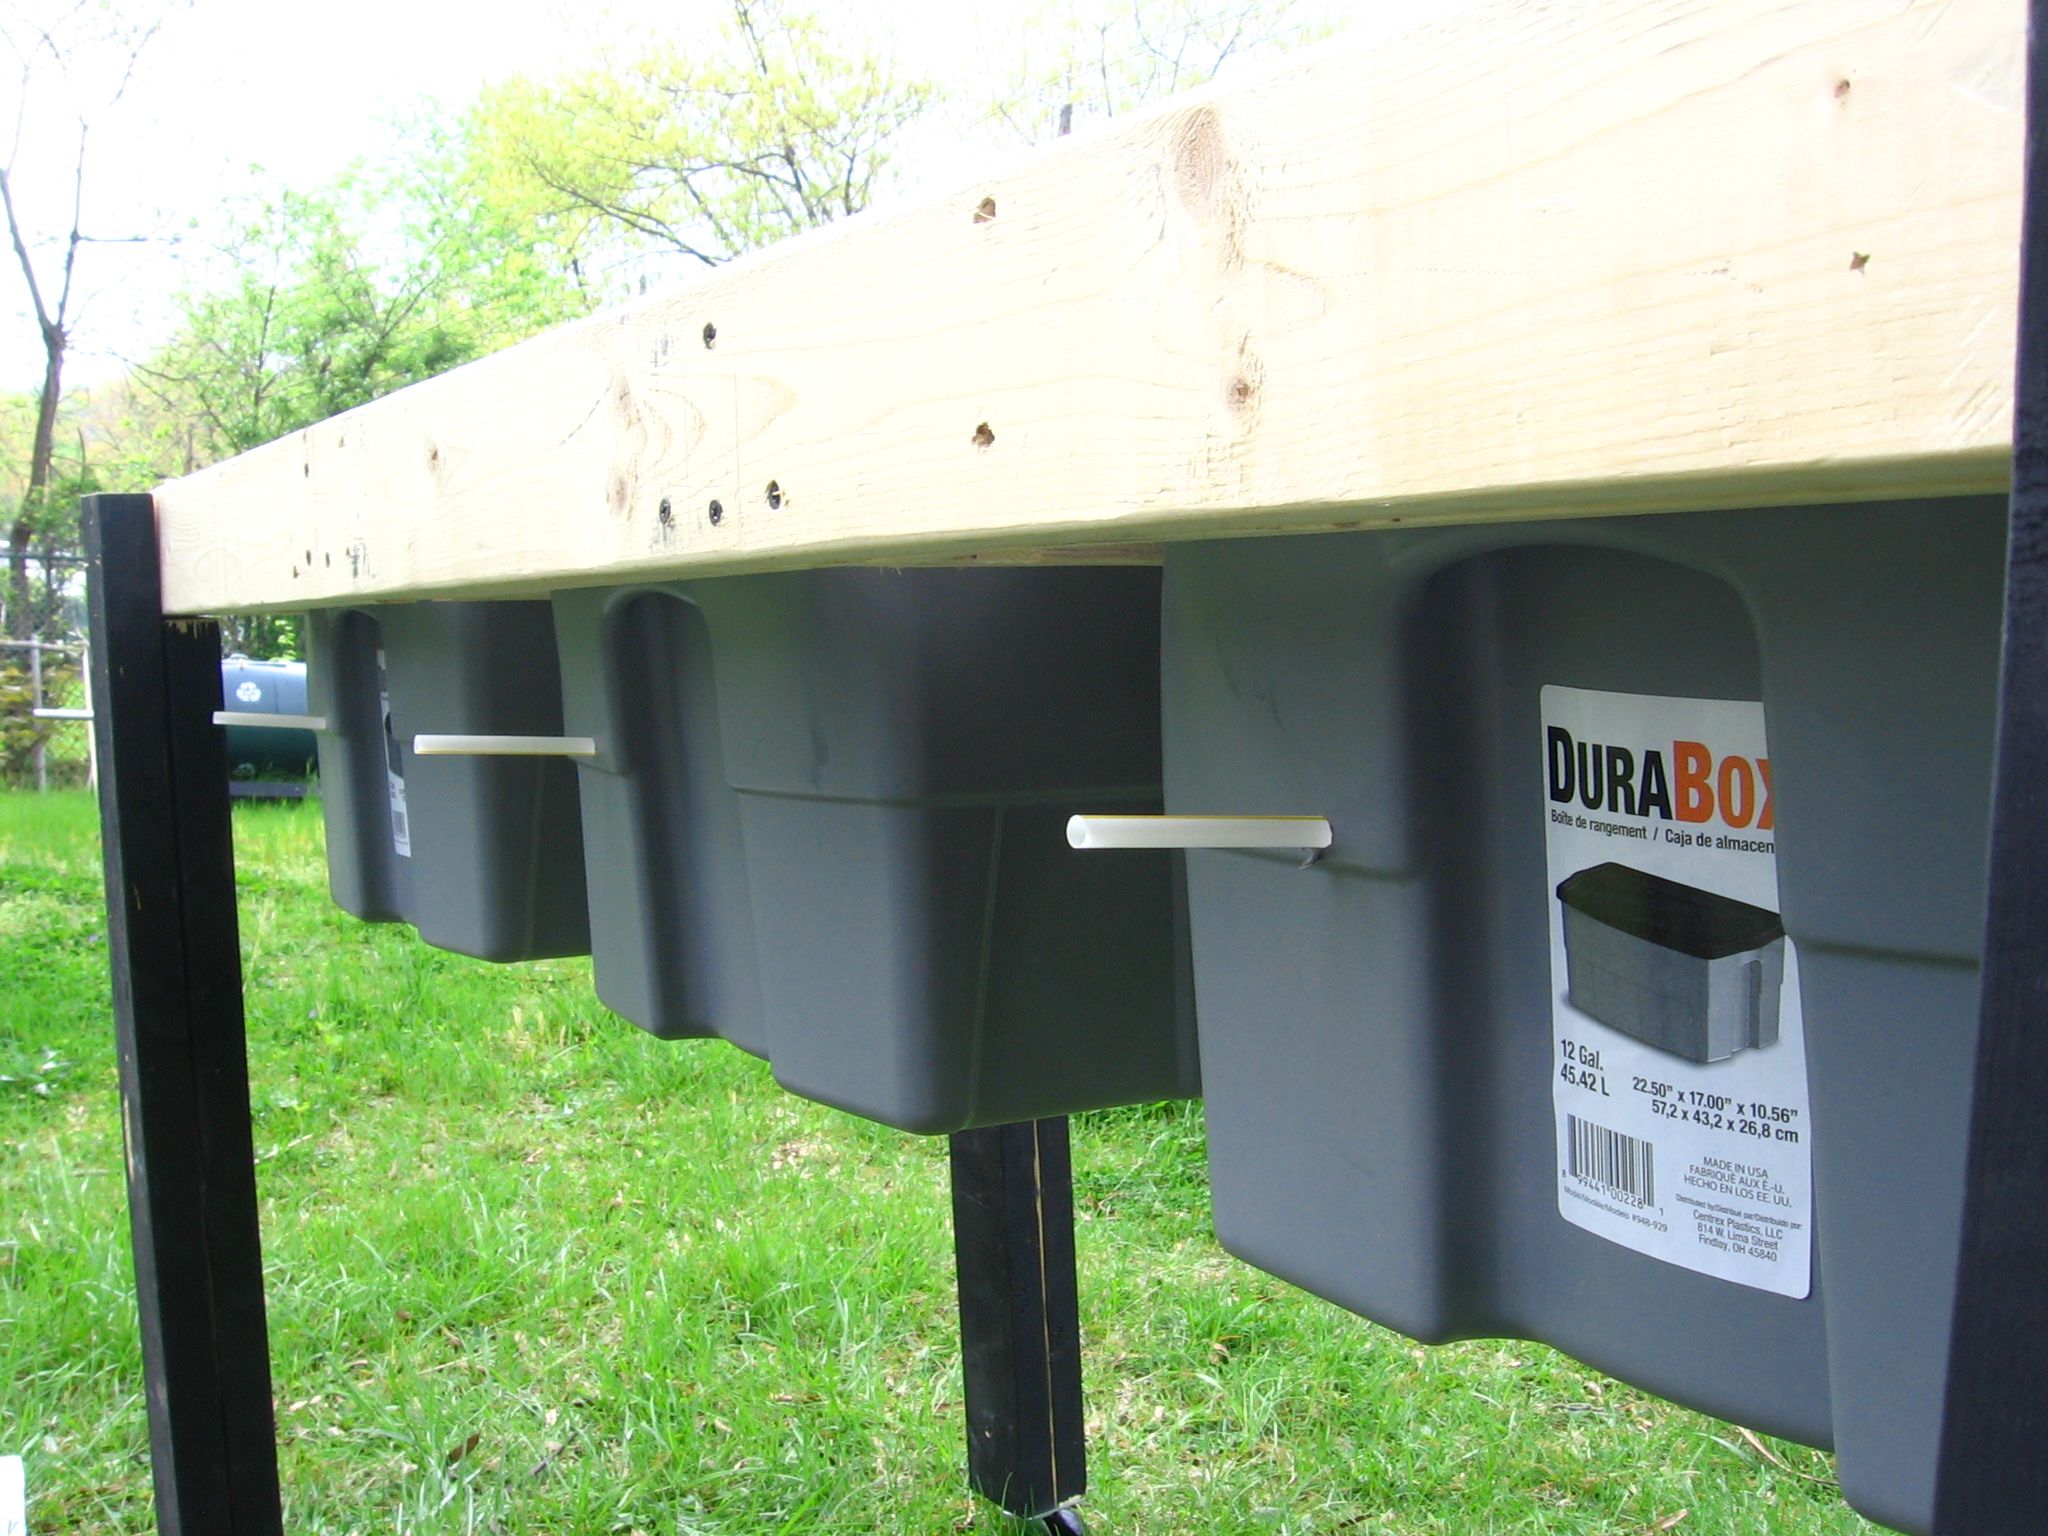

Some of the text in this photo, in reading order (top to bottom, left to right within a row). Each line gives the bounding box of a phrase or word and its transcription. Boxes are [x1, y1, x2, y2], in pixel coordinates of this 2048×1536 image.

[1575, 813, 1587, 828] de
[1589, 821, 1647, 839] rangement
[1653, 827, 1659, 841] /
[1665, 828, 1692, 847] Caja
[1696, 832, 1712, 848] de
[1561, 1039, 1604, 1071] 12 Gal.
[1560, 1063, 1610, 1097] 45.42 L
[1677, 1090, 1685, 1103] x
[1737, 1103, 1745, 1116] x
[1652, 1099, 1798, 1144] 57,2 x 43,2 x 26,8 cm
[1703, 1156, 1768, 1178] MADE IN USA
[1739, 1176, 1760, 1189] AUX
[1577, 1174, 1606, 1195] 99441
[1610, 1188, 1644, 1210] 00228
[1659, 1207, 1664, 1216] 1
[1684, 1174, 1718, 1191] HECHO
[1720, 1183, 1733, 1195] EN
[1735, 1187, 1754, 1200] LOS
[1773, 1195, 1792, 1207] UU.
[1693, 1209, 1725, 1225] Centrex
[1765, 1226, 1783, 1240] LLC
[1697, 1222, 1713, 1235] 814
[1727, 1229, 1749, 1244] Lima
[1751, 1236, 1778, 1251] Street
[1732, 1242, 1746, 1254] OH
[1748, 1246, 1777, 1262] 45840
